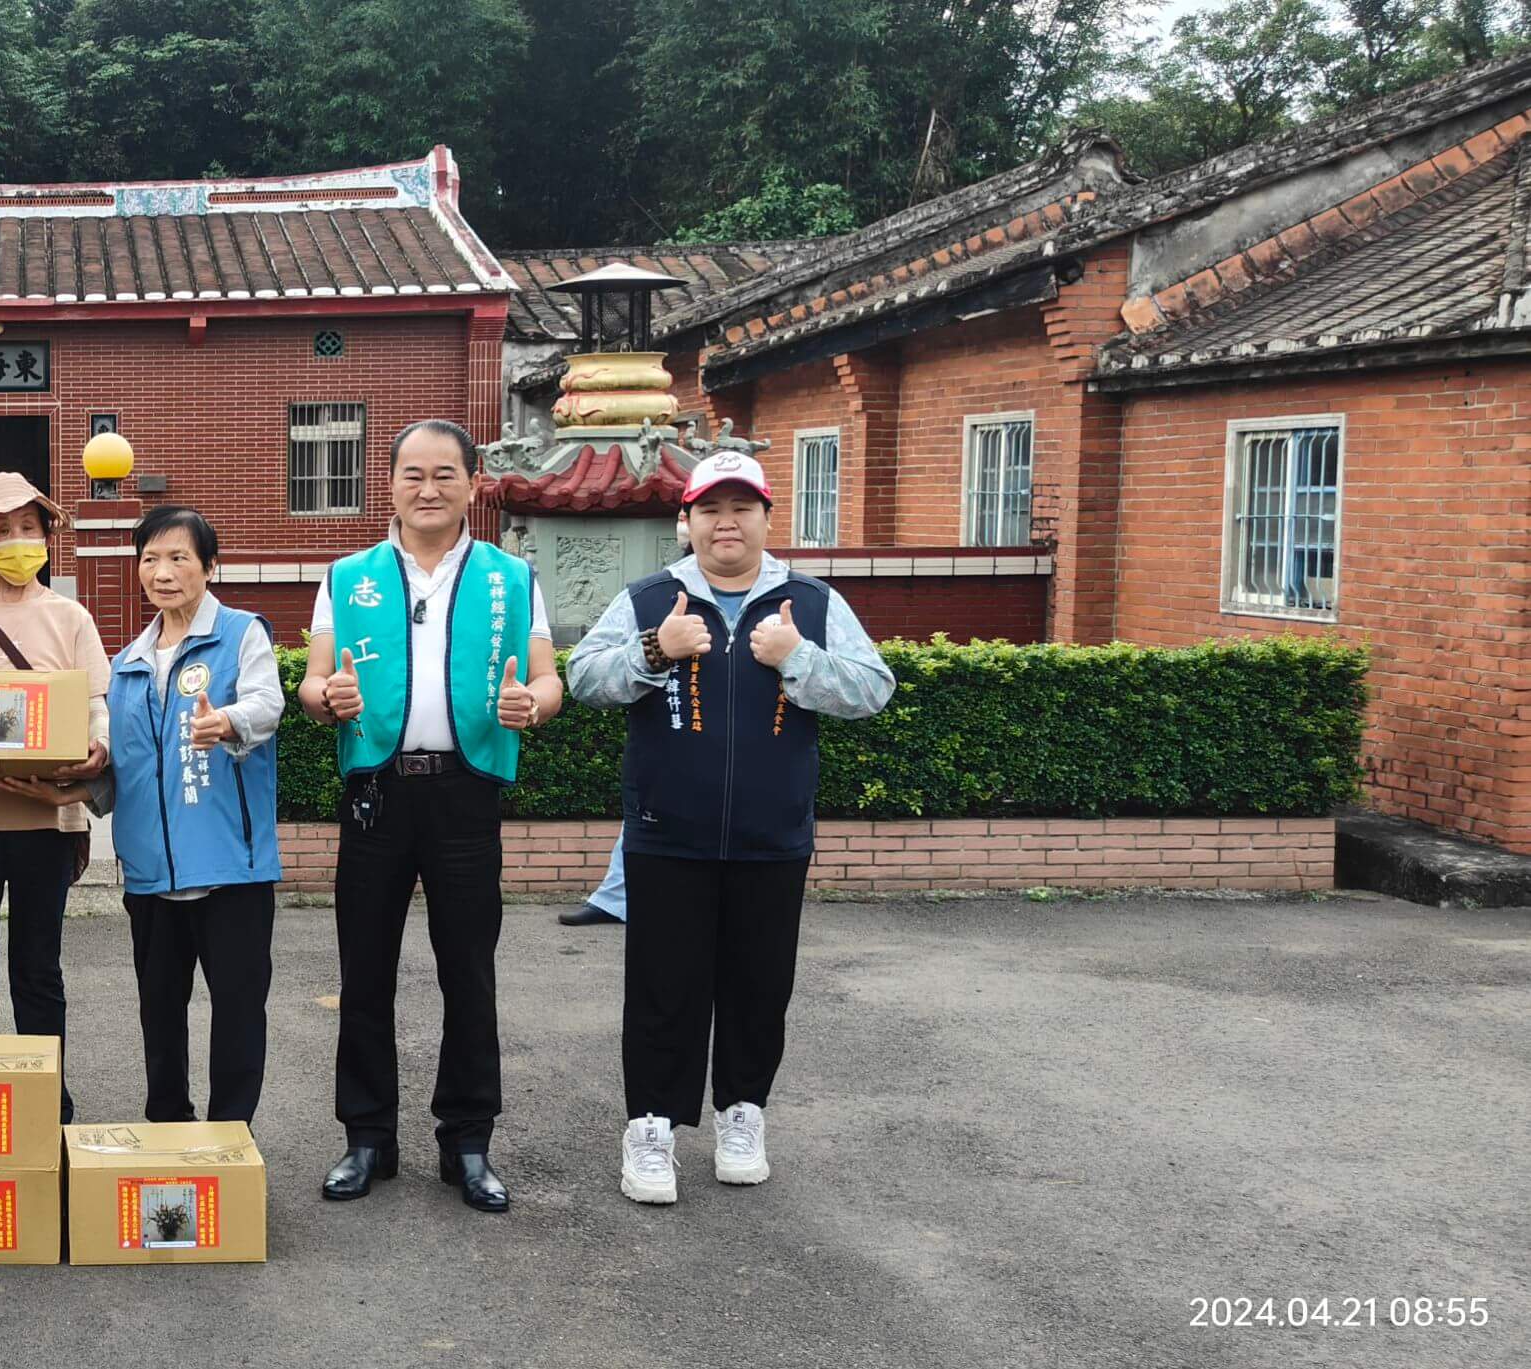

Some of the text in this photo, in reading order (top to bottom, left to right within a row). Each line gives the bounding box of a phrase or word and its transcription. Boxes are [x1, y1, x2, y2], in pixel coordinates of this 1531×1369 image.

[348, 576, 383, 665] 志工
[486, 571, 507, 715] 隆祥經濟發展基金會
